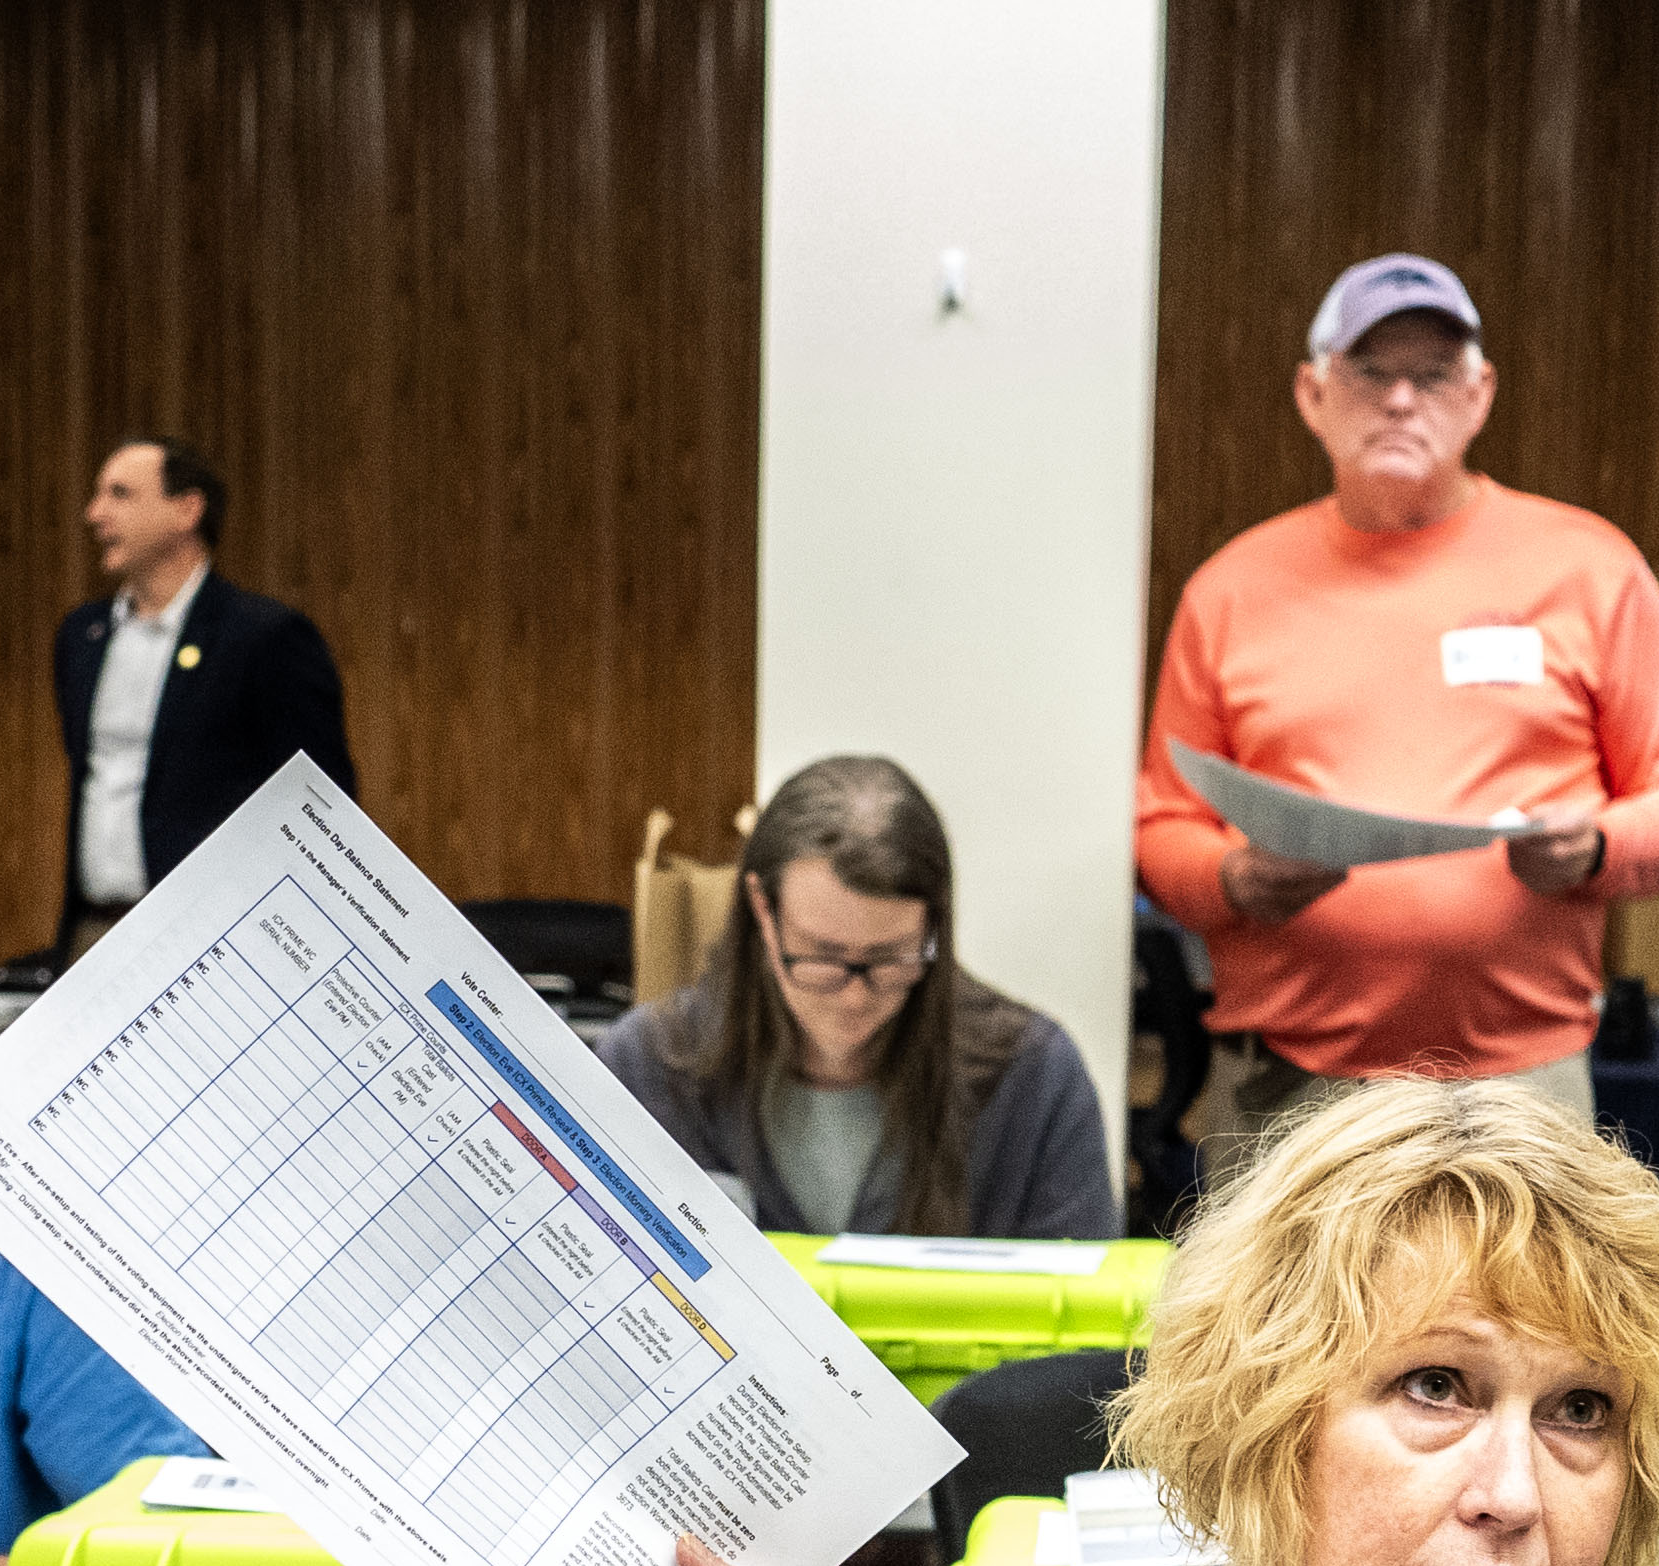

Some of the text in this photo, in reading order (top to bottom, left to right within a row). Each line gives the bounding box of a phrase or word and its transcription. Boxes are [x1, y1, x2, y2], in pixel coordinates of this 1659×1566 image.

[300, 802, 410, 918] Election Day Balance Statement
[277, 823, 413, 965] Step 1 is the Manager's Verification Statement.
[257, 918, 311, 974] SERIAL NUMBER
[270, 912, 317, 961] ICX PRIME WC
[194, 960, 210, 975] WC
[210, 945, 225, 960] WC
[163, 989, 179, 1005] WC
[179, 974, 195, 990] WC
[329, 967, 384, 1024] Protective Counter
[459, 971, 505, 1020] Vote Center:
[148, 1004, 164, 1019] WC
[320, 977, 372, 1030] (Entered Election
[118, 1033, 133, 1048] WC
[133, 1018, 149, 1034] WC
[396, 1001, 448, 1055] ICX Prime Counts
[102, 1047, 118, 1063] WC
[362, 1039, 387, 1064] Check)
[374, 1035, 392, 1052] (AM
[88, 1061, 104, 1077] WC
[419, 1043, 457, 1082] Total Ballots
[419, 1062, 438, 1081] Cast
[73, 1076, 89, 1091] WC
[389, 1068, 428, 1108] Election Eve
[403, 1065, 433, 1096] (Entered
[45, 1104, 61, 1119] WC
[58, 1089, 74, 1105] WC
[31, 1117, 47, 1132] WC
[433, 1113, 457, 1138] Check)
[445, 1109, 462, 1126] (AM
[446, 1002, 689, 1259] Step 2: Election Eve ICX Prime Re-seal & Step 3: Election Morning Verification
[480, 1137, 516, 1175] Plastic Seal
[520, 1132, 548, 1162] DOOR A
[599, 1216, 628, 1246] DOOR B
[676, 1202, 711, 1238] Election:
[558, 1222, 594, 1259] Plastic Seal
[637, 1306, 673, 1344] Plastic Seal
[678, 1301, 707, 1331] DOOR D
[817, 1355, 863, 1400] Page of
[747, 1374, 790, 1419] Instructions:
[725, 1393, 811, 1482] record the Protective Counter
[734, 1384, 814, 1466] During Election Eve Setup,
[665, 1446, 756, 1542] Total Ballots Cast must be zero
